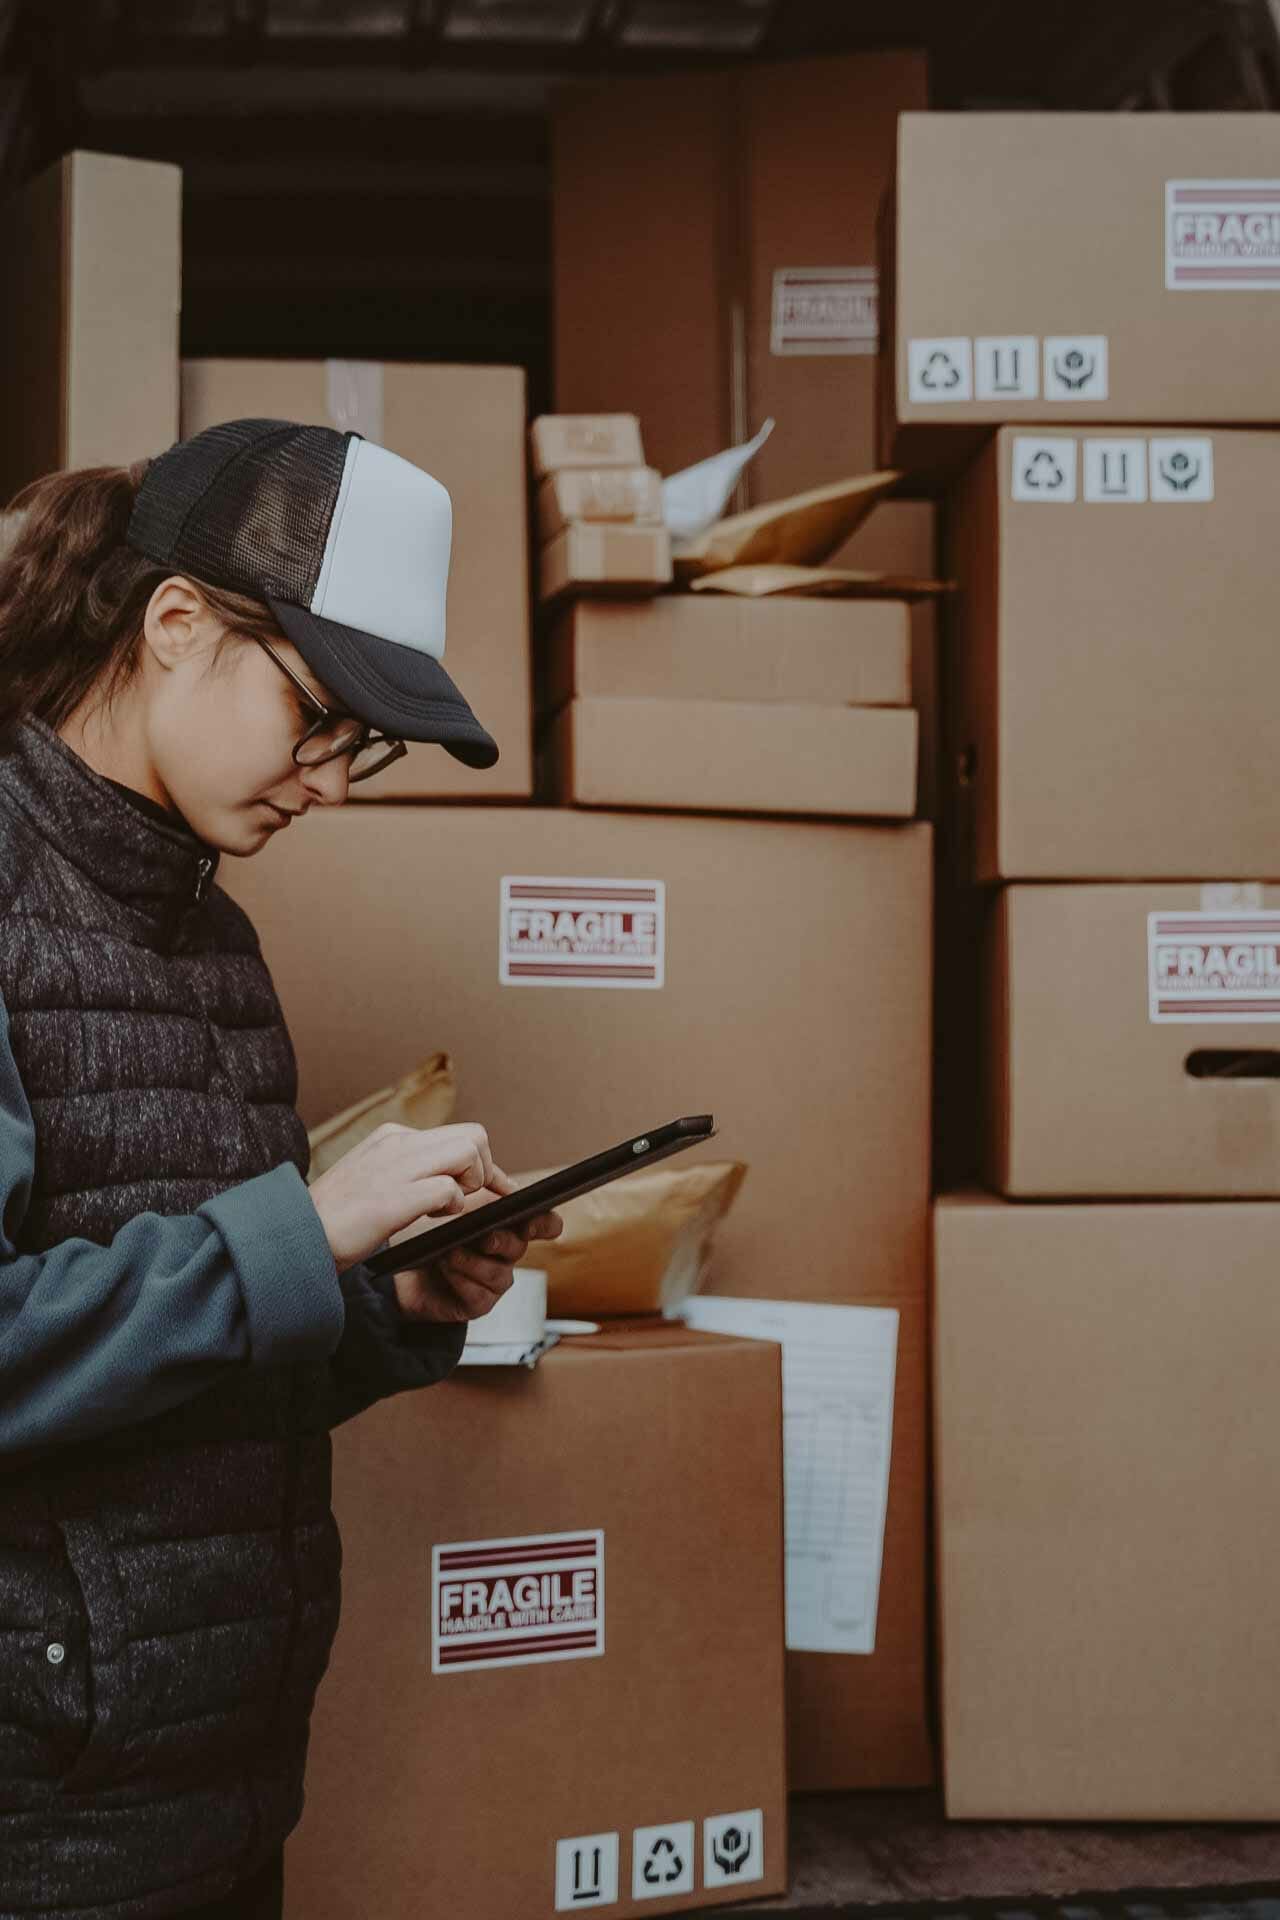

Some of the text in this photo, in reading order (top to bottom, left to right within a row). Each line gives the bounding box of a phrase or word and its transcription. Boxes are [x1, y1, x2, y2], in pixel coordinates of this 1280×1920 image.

[510, 910, 656, 942] FRAGILE
[441, 1570, 595, 1618] FRAGILE
[440, 1602, 594, 1634] HANDLE WITH CARE
